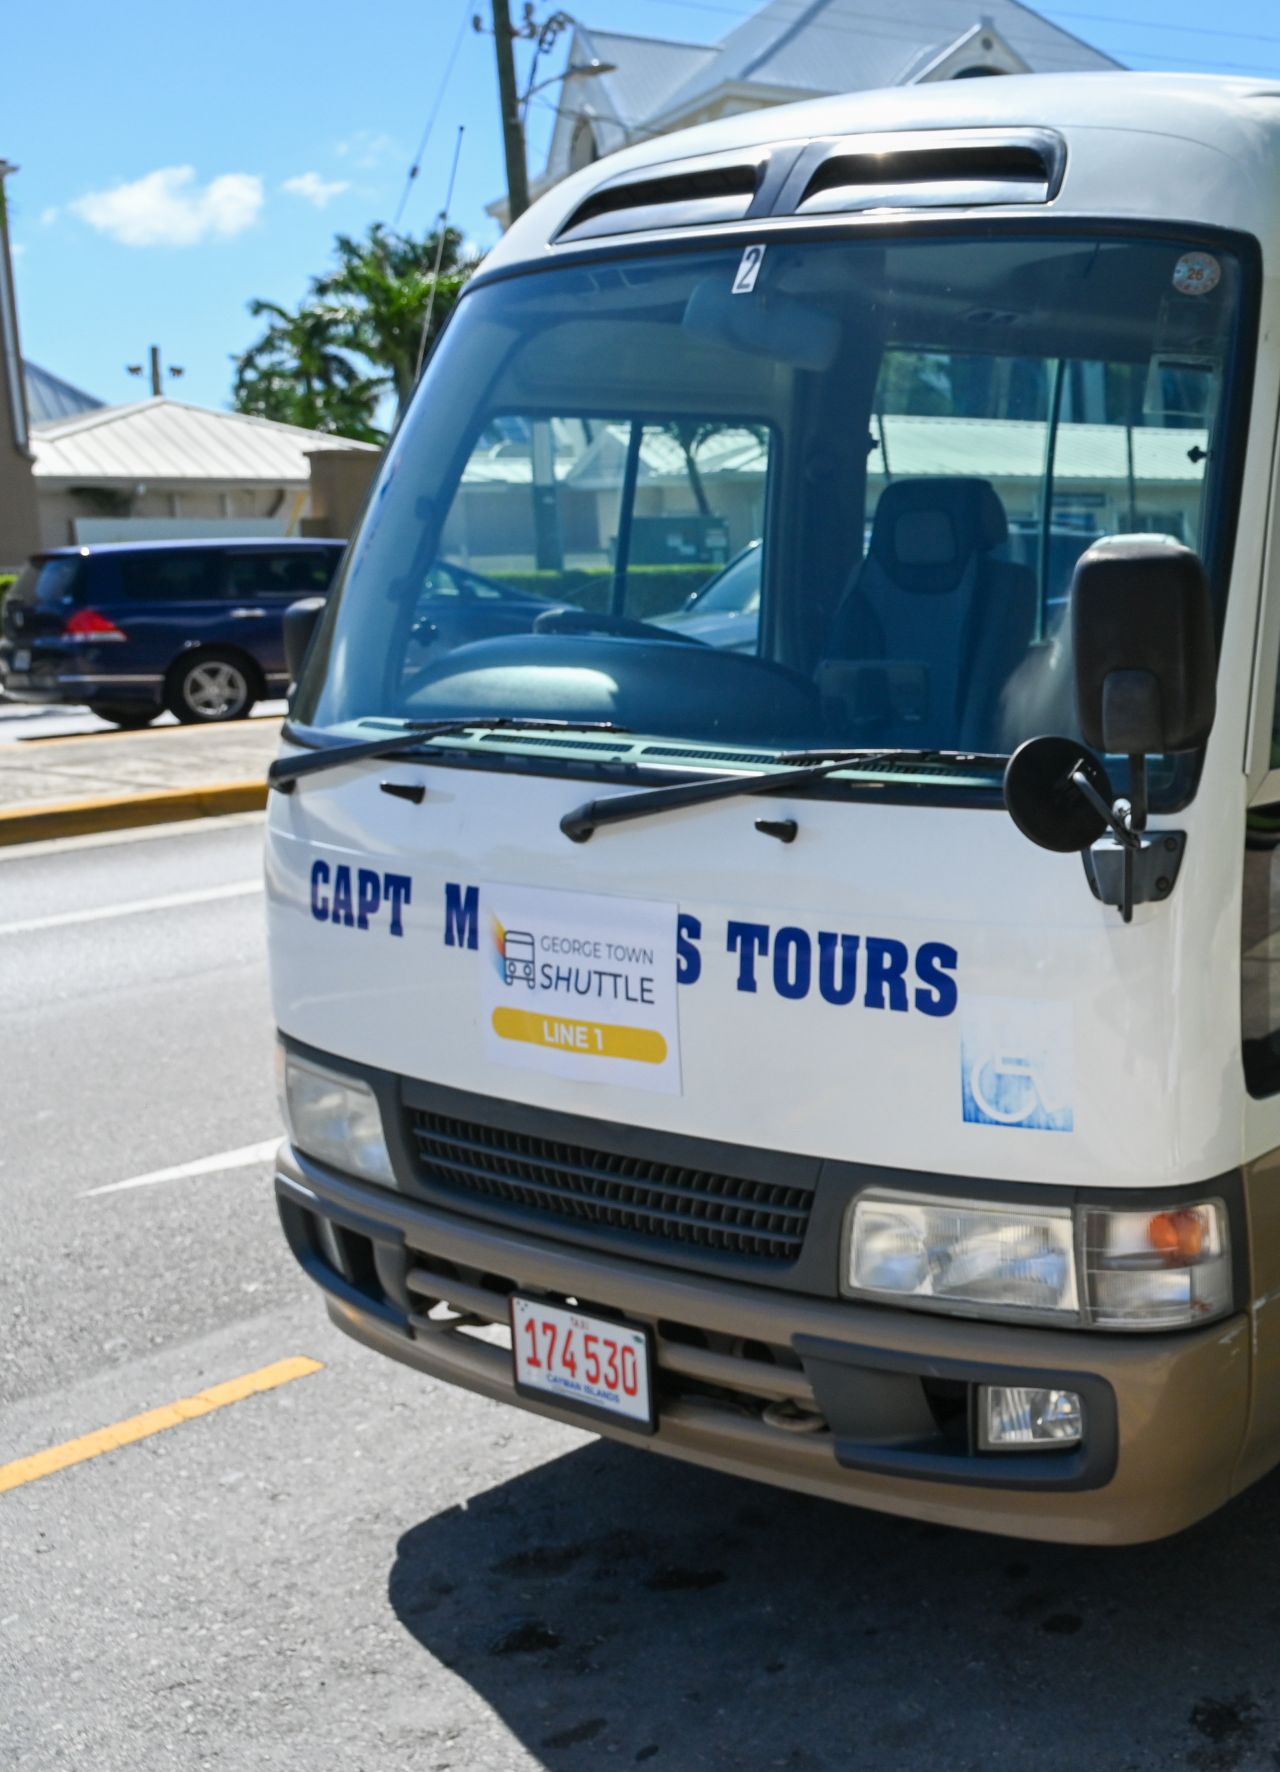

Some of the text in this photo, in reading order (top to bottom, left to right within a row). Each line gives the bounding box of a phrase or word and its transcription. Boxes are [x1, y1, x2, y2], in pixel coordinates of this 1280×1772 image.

[735, 247, 761, 290] 2
[310, 859, 412, 938] CAPT
[726, 920, 958, 1017] TOURS
[540, 934, 654, 965] GEORGE TOWN
[540, 963, 655, 1005] SHUTTLE
[543, 1019, 604, 1051] LINE 1
